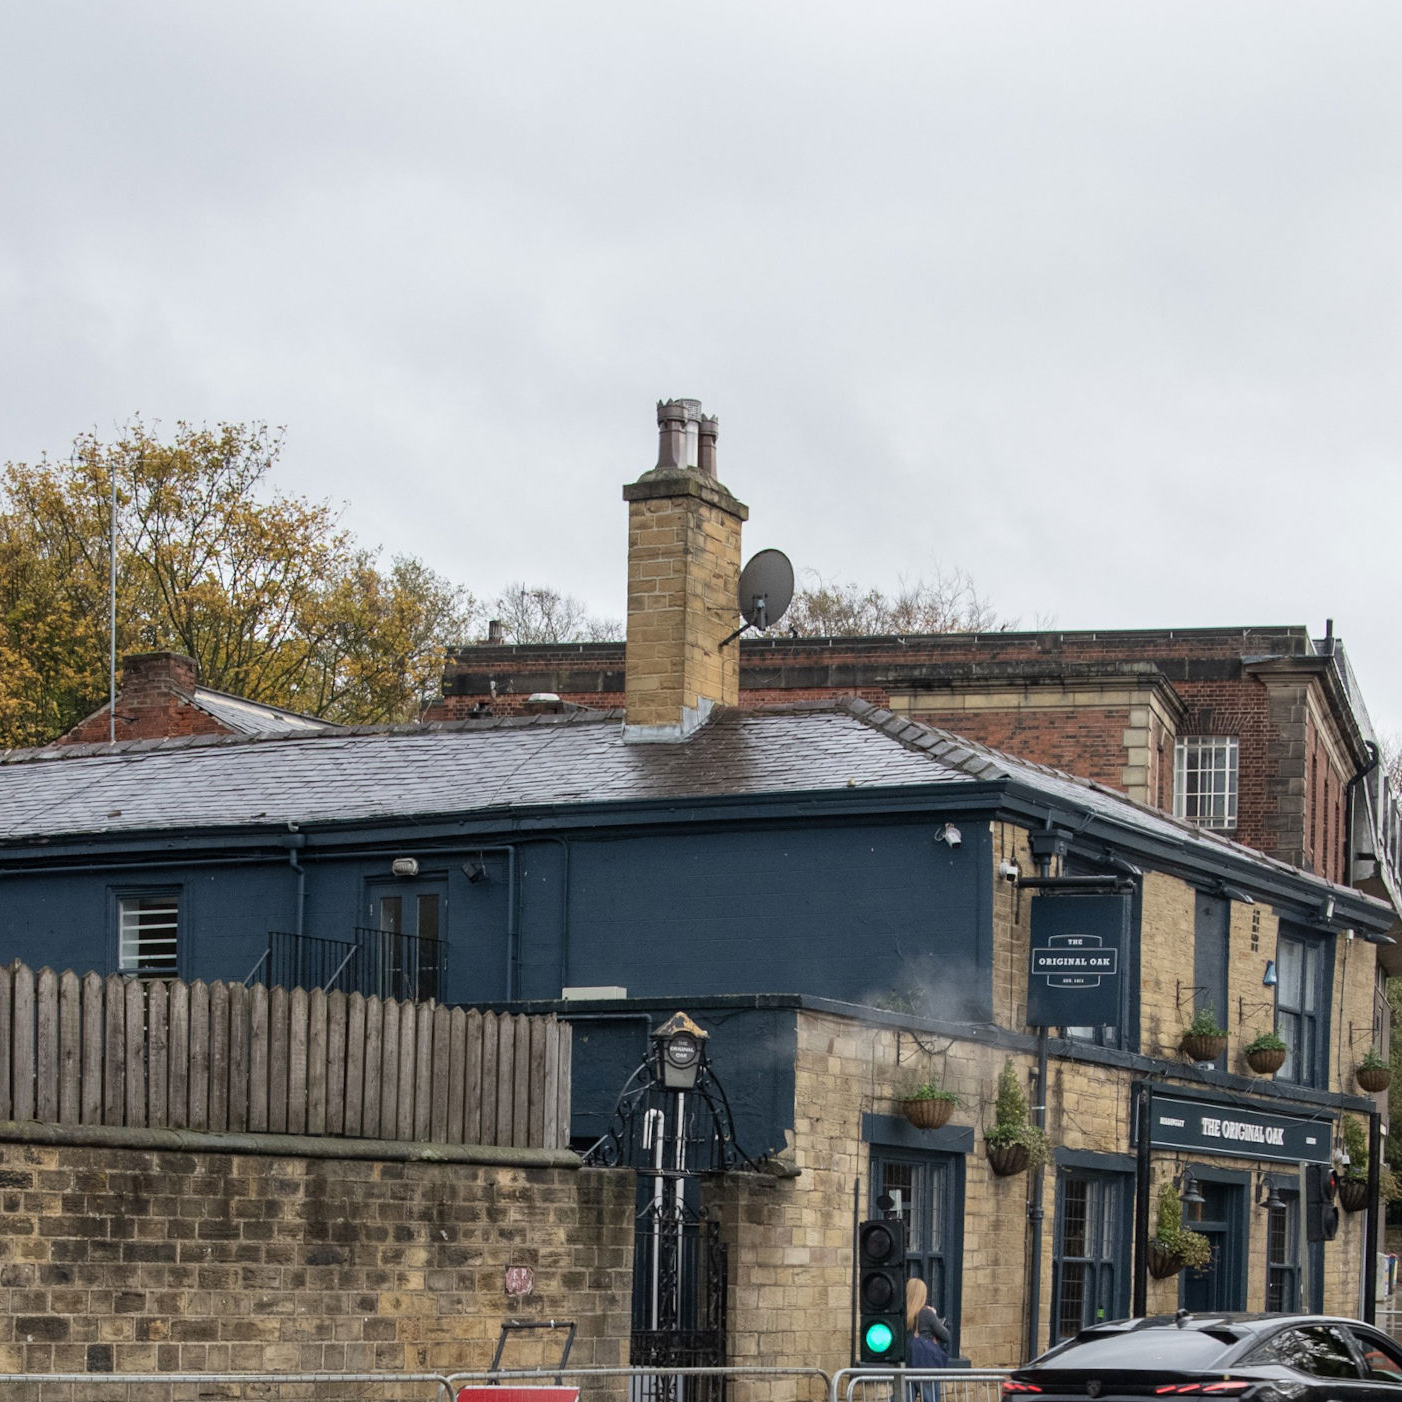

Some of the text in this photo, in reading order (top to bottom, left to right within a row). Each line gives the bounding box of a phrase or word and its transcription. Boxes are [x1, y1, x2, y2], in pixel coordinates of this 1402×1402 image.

[1038, 957, 1110, 966] ORIGINAL OAK
[1201, 1117, 1221, 1137] THE
[1221, 1120, 1265, 1143] ORIGINAL
[1265, 1127, 1284, 1146] OAK
